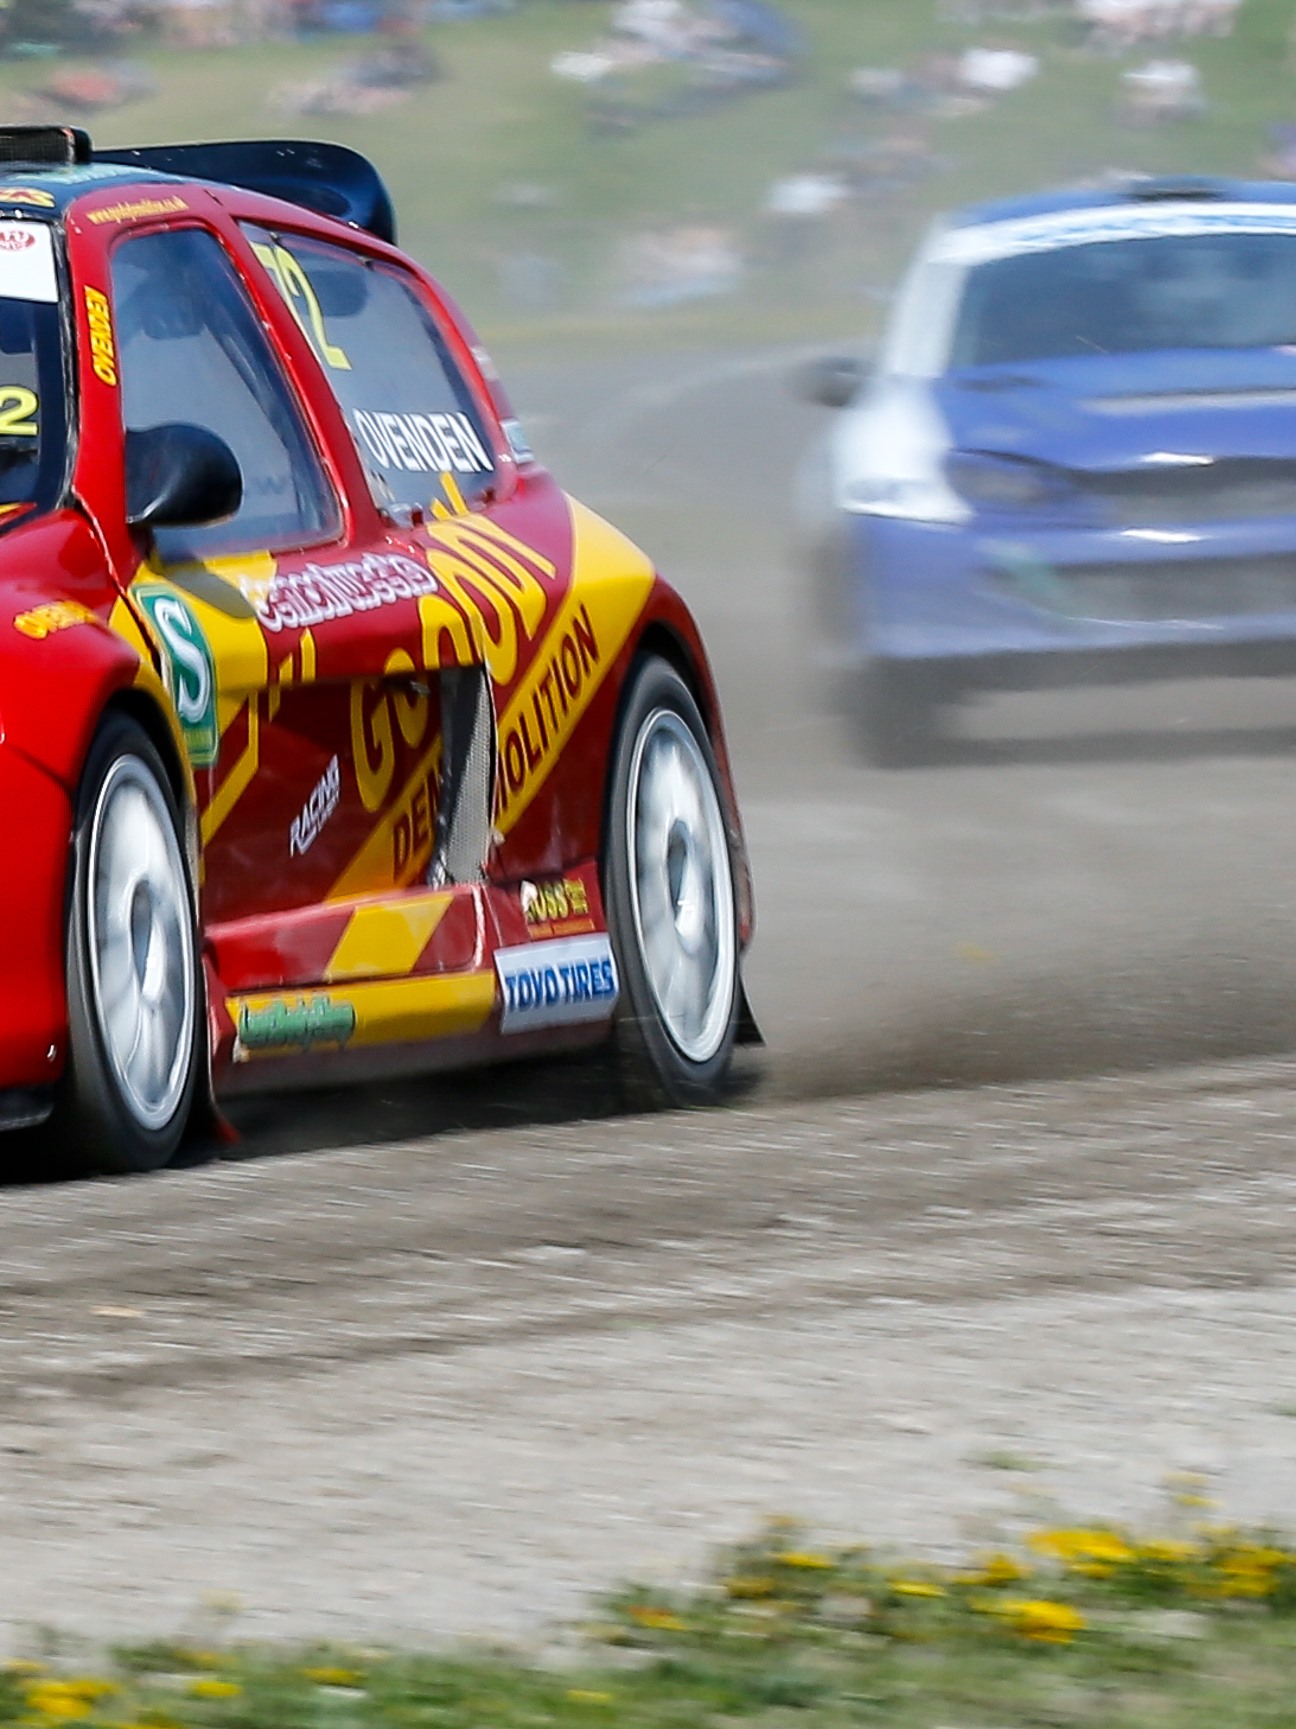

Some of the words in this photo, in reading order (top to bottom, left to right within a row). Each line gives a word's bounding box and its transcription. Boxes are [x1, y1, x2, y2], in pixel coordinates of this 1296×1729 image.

[83, 284, 117, 387] OVENDEN
[351, 407, 495, 473] OVENDEN
[504, 967, 560, 1012] TOYO
[559, 959, 616, 1002] TIRES
